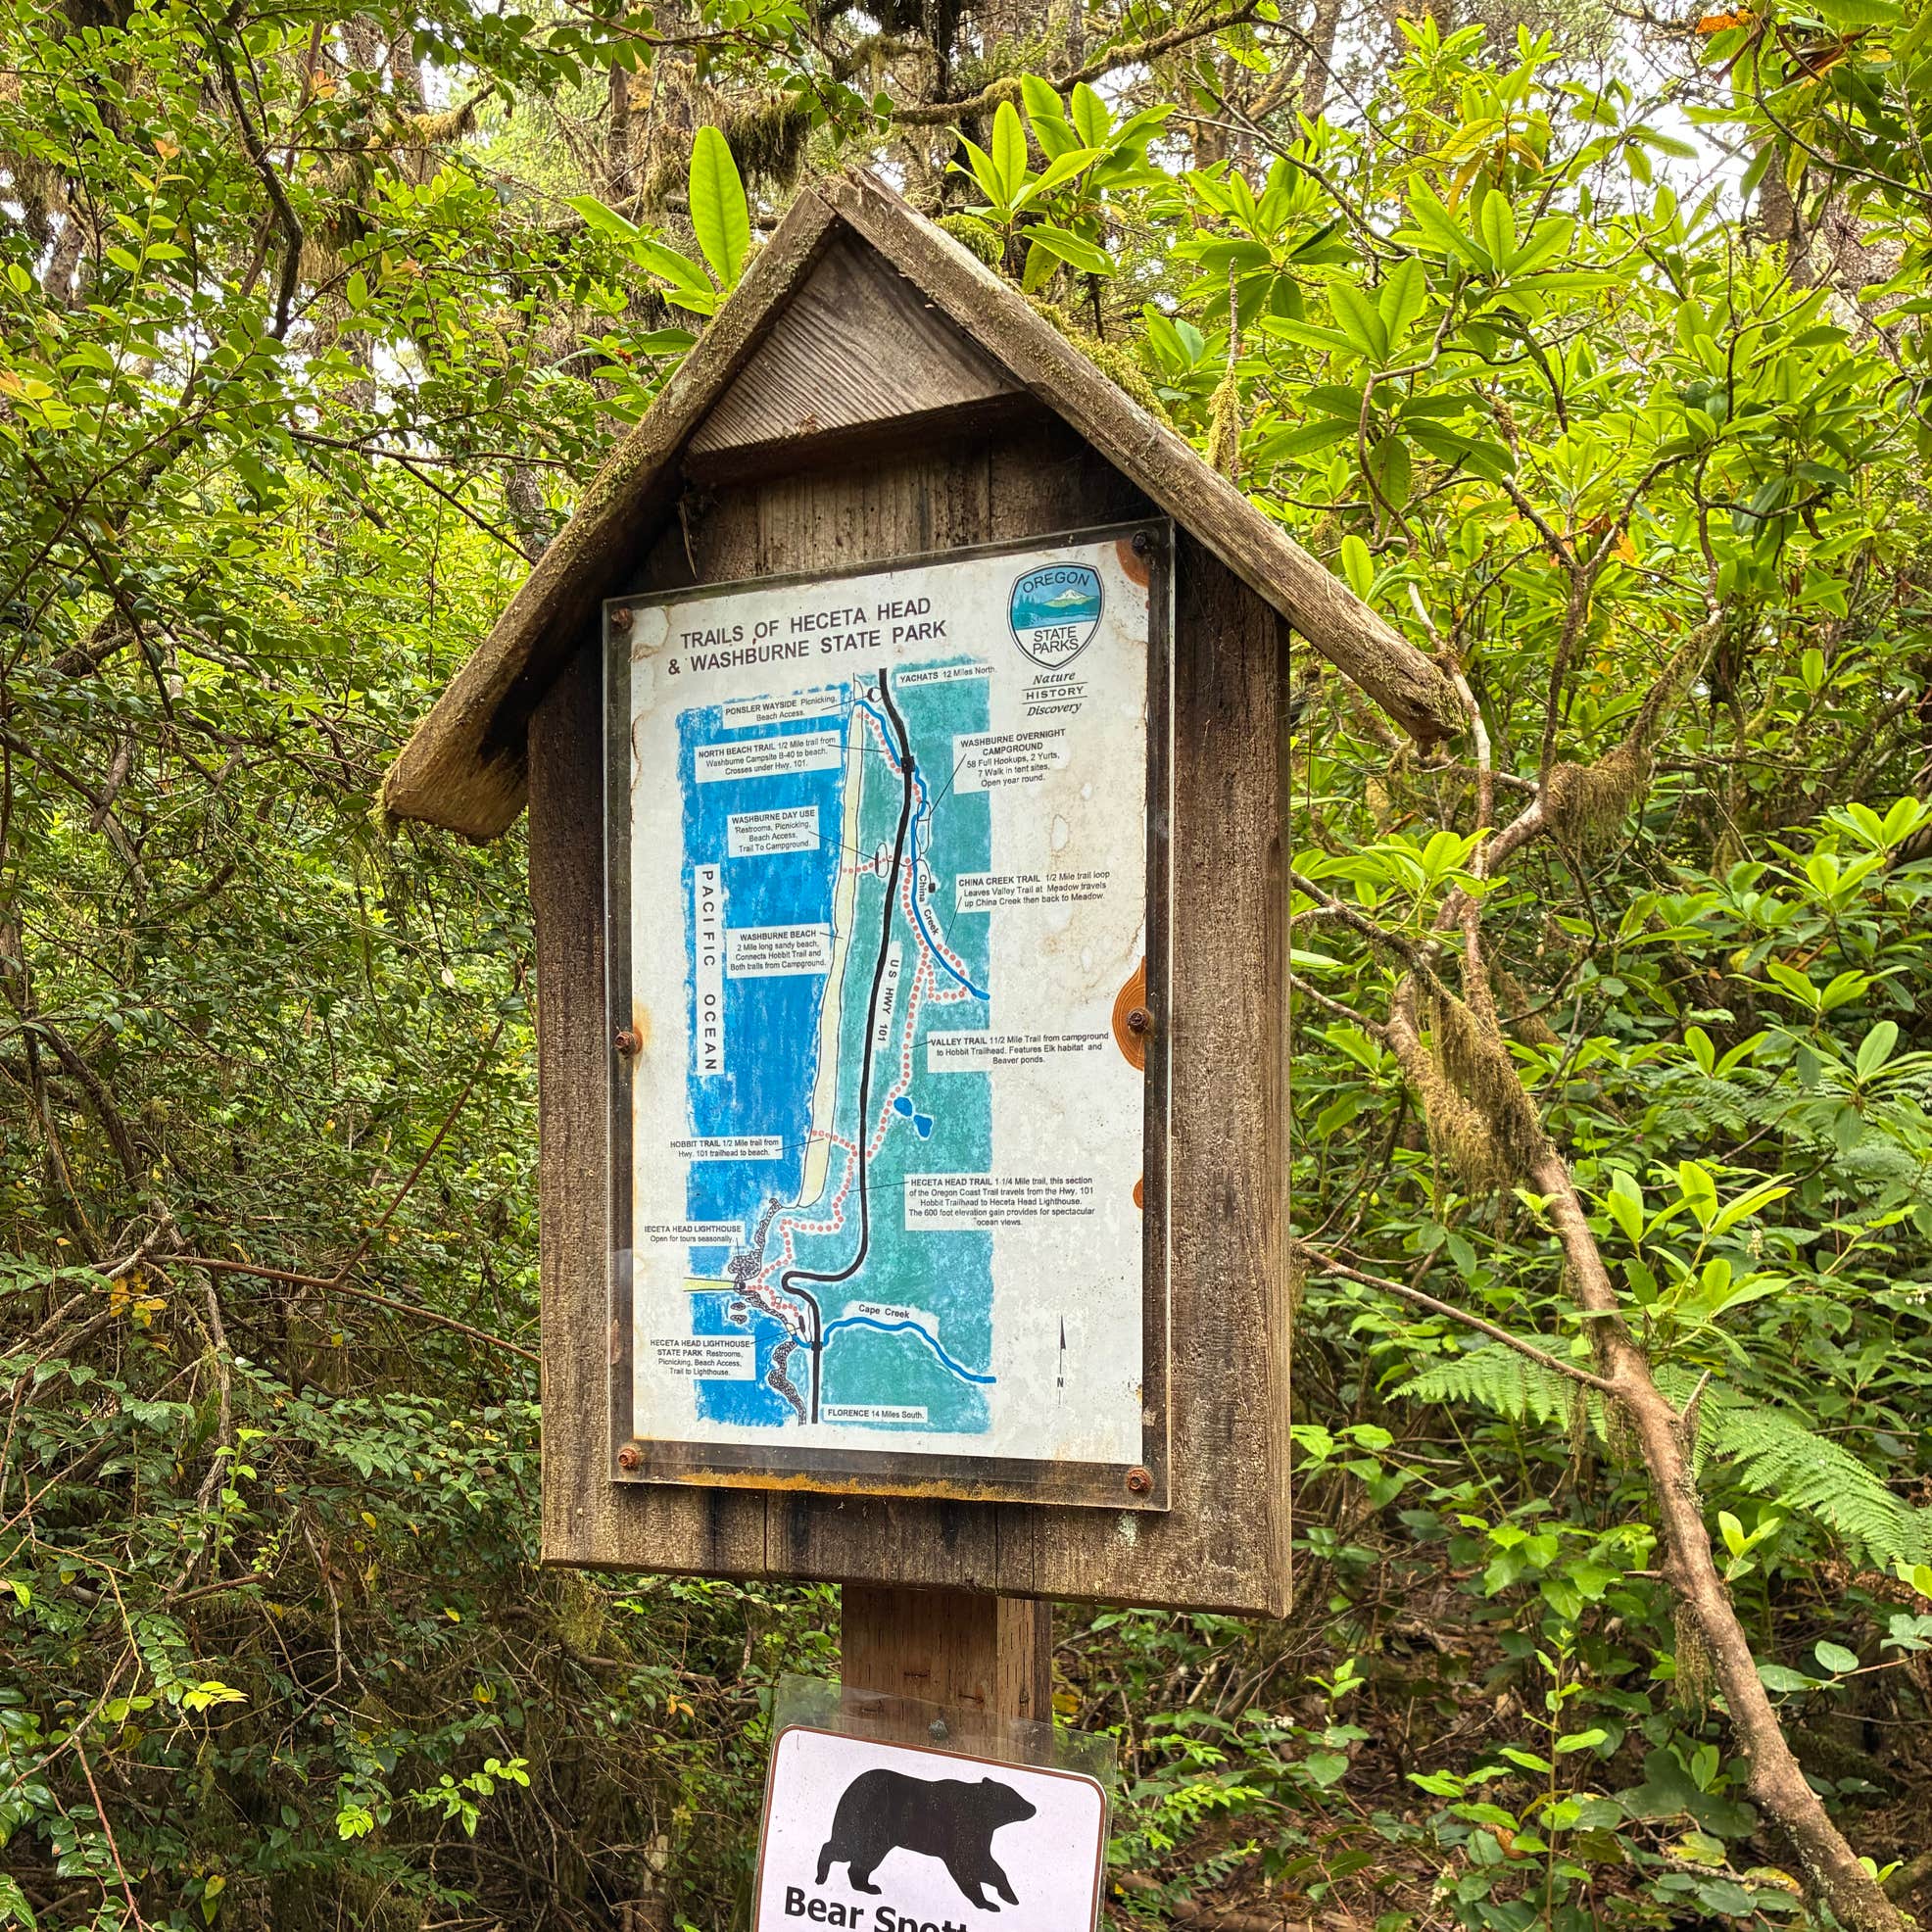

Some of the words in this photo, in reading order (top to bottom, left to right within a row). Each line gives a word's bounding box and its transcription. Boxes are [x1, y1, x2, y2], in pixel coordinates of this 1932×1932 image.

[1023, 571, 1089, 593] OREGON
[680, 625, 744, 650] TRAILS
[754, 619, 780, 639] OF
[791, 607, 867, 634] HECETA
[877, 598, 931, 621] HEAD
[1034, 626, 1077, 643] STATE
[668, 658, 681, 675] &
[690, 640, 810, 672] WASHBURNE
[820, 629, 881, 654] STATE
[893, 620, 947, 644] PARK
[1033, 639, 1079, 655] PARKS
[900, 671, 939, 683] YACHATS
[1033, 671, 1076, 686] Nature
[1026, 686, 1084, 700] HISTORY
[725, 704, 761, 716] PONSLER
[762, 700, 797, 711] WAYSIDE
[1027, 702, 1083, 716] Discovery
[756, 713, 778, 722] Beach
[960, 734, 1014, 748] WASHBURNE
[1016, 728, 1066, 742] OVERNIGHT
[699, 749, 725, 758] NORTH
[726, 746, 752, 755] BEACH
[751, 743, 776, 753] TRAIL
[983, 742, 1043, 756] CAMPGROUND
[705, 756, 745, 767] Washburne
[746, 752, 777, 765] Campsite
[779, 750, 795, 759] B-40
[967, 760, 976, 769] 58
[978, 758, 991, 767] Full
[725, 766, 752, 776] Crosses
[753, 763, 773, 773] under
[985, 767, 1004, 777] Walk
[981, 779, 1001, 788] Open
[1002, 777, 1020, 787] year
[732, 812, 781, 824] WASHBURNE
[782, 811, 797, 820] DAY
[799, 809, 815, 818] USE
[958, 877, 985, 887] CHINA
[986, 876, 1014, 886] CREEK
[1016, 874, 1040, 884] TRAIL
[1059, 872, 1075, 881] Mile
[1077, 871, 1091, 880] trail
[1093, 870, 1110, 880] loop
[963, 889, 990, 897] Leaves
[991, 887, 1015, 896] Valley
[1047, 883, 1080, 893] Meadow
[1081, 881, 1107, 891] travels
[964, 900, 974, 909] up
[999, 896, 1021, 905] Creek
[1041, 894, 1059, 903] back
[701, 870, 715, 967] PACIFIC
[924, 908, 939, 936] Creek
[740, 931, 789, 942] WASHBURNE
[790, 929, 816, 939] BEACH
[758, 942, 773, 951] long
[774, 942, 795, 950] sandy
[736, 952, 767, 961] Connects
[792, 949, 807, 958] Trail
[883, 988, 894, 1015] HWY
[703, 993, 717, 1070] OCEAN
[877, 1023, 888, 1041] 101
[931, 1038, 962, 1046] VALLEY
[964, 1037, 988, 1045] TRAIL
[1042, 1034, 1060, 1042] from
[1061, 1032, 1109, 1042] campground
[1009, 1045, 1042, 1054] Features
[1043, 1044, 1056, 1053] Elk
[1057, 1043, 1084, 1052] habitat
[944, 1178, 967, 1186] HEAD
[931, 1188, 958, 1198] Oregon
[1017, 1197, 1038, 1206] Head
[924, 1208, 938, 1217] 600
[989, 1209, 1005, 1218] gain
[1051, 1207, 1095, 1217] spectacular
[858, 1304, 881, 1315] Cape
[885, 1308, 910, 1319] Creek
[1057, 1377, 1064, 1388] N
[828, 1409, 870, 1418] FLORENCE
[785, 1885, 864, 1930] Bear
